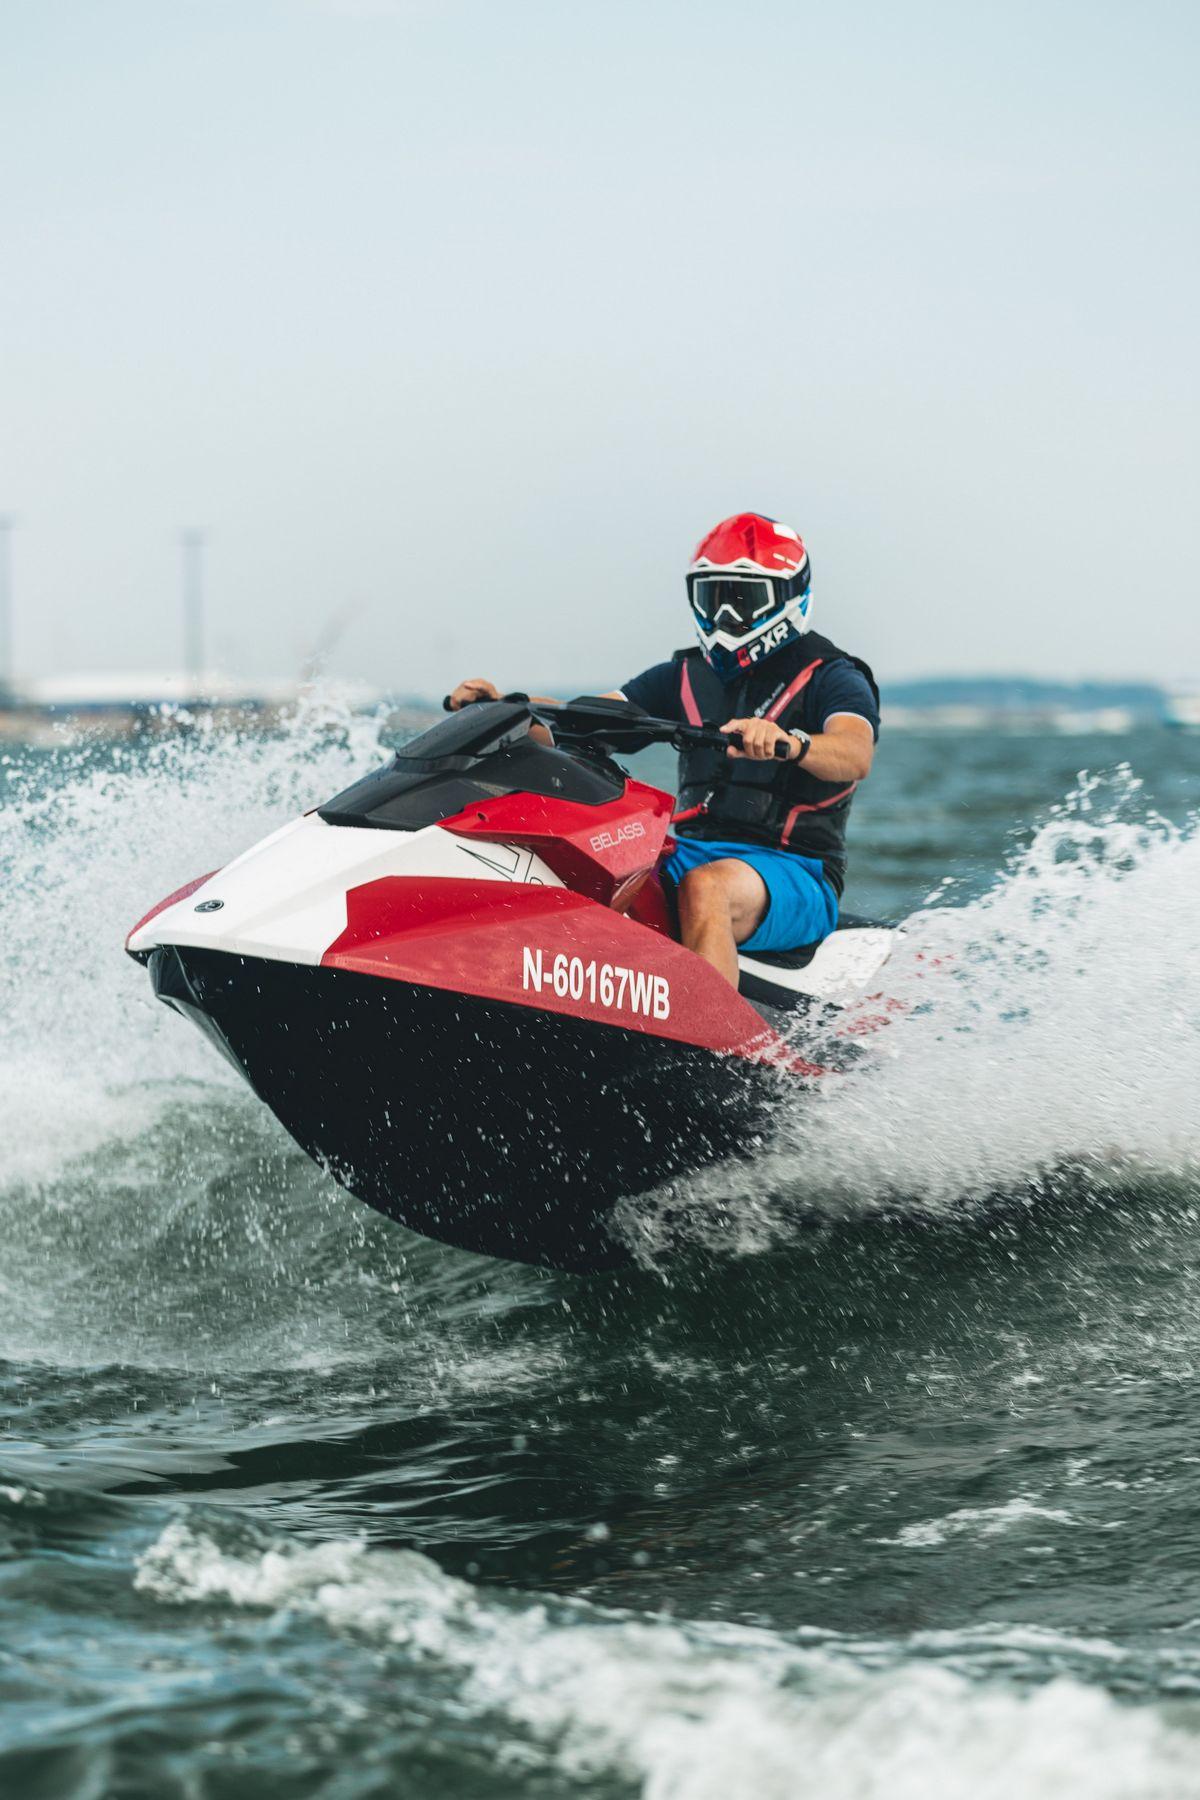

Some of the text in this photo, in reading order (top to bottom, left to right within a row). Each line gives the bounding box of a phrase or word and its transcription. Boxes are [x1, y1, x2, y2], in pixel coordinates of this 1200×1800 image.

[749, 621, 789, 662] FXR
[589, 822, 646, 852] BELASSI
[522, 946, 671, 1020] N-60167WB
